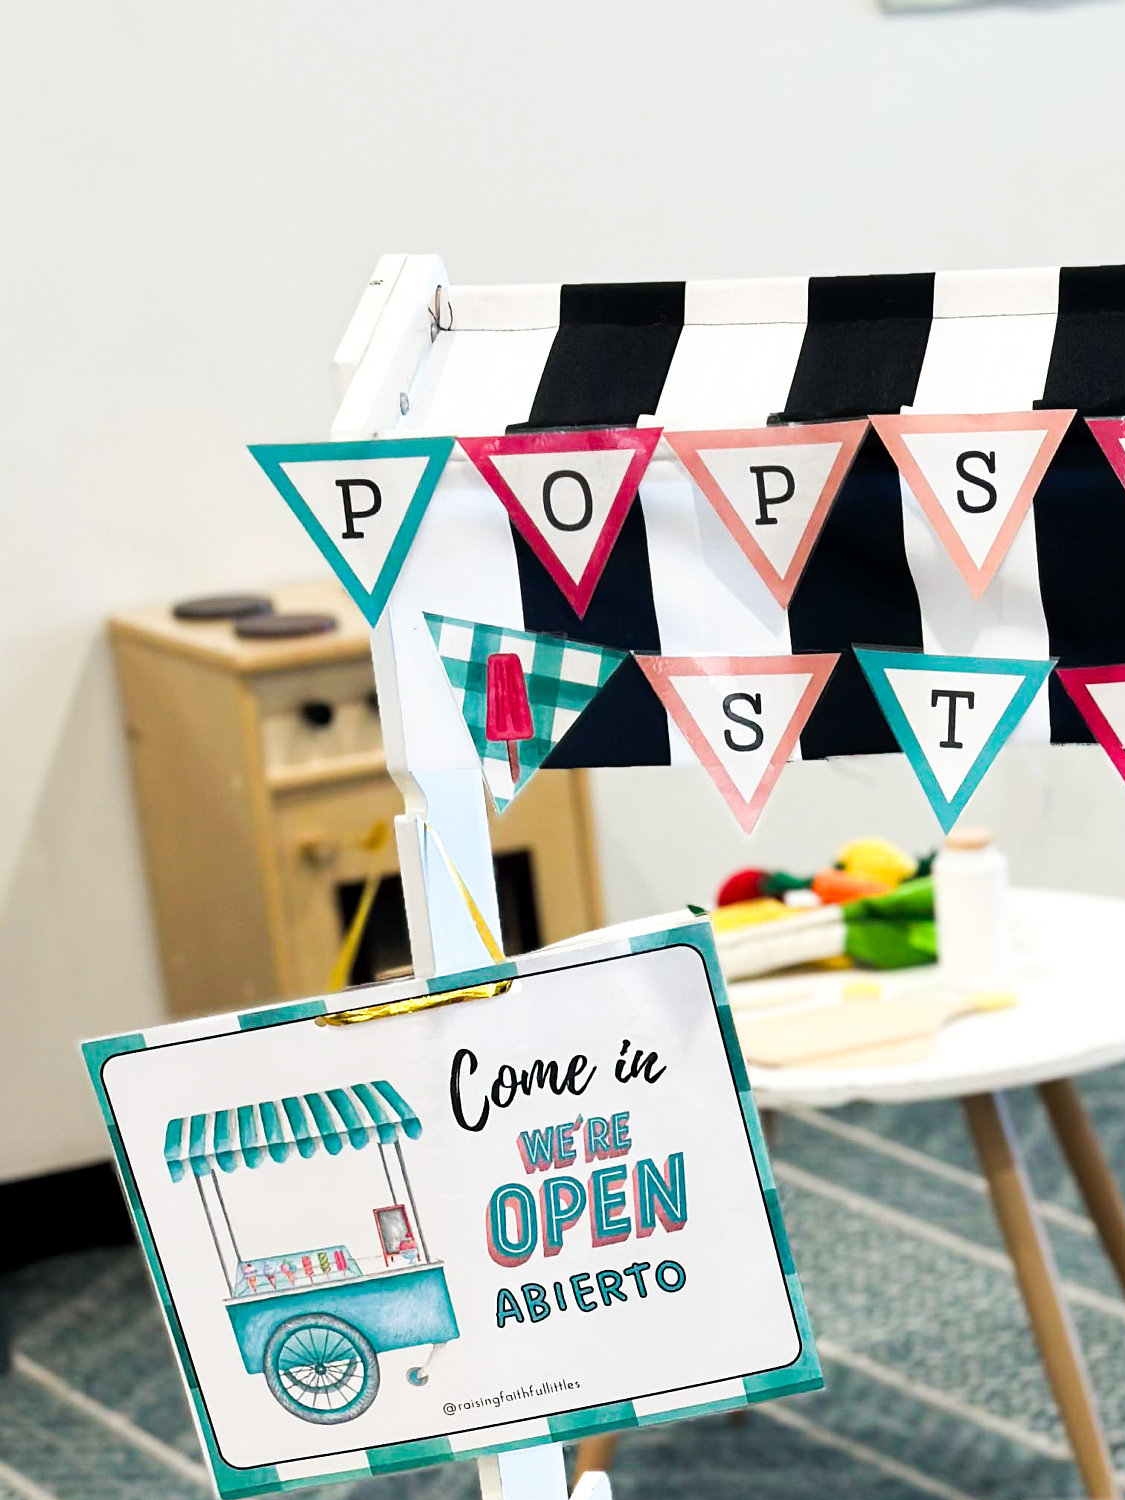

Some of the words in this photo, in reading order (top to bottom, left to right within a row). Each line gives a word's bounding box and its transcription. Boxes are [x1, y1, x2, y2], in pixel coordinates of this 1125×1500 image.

[449, 1048, 596, 1132] Come
[615, 1039, 666, 1083] in
[517, 1111, 632, 1174] WE'RE
[486, 1152, 688, 1268] OPEN
[495, 1260, 687, 1328] ABIERTO
[443, 1379, 581, 1416] @raisingfaithfullittles
